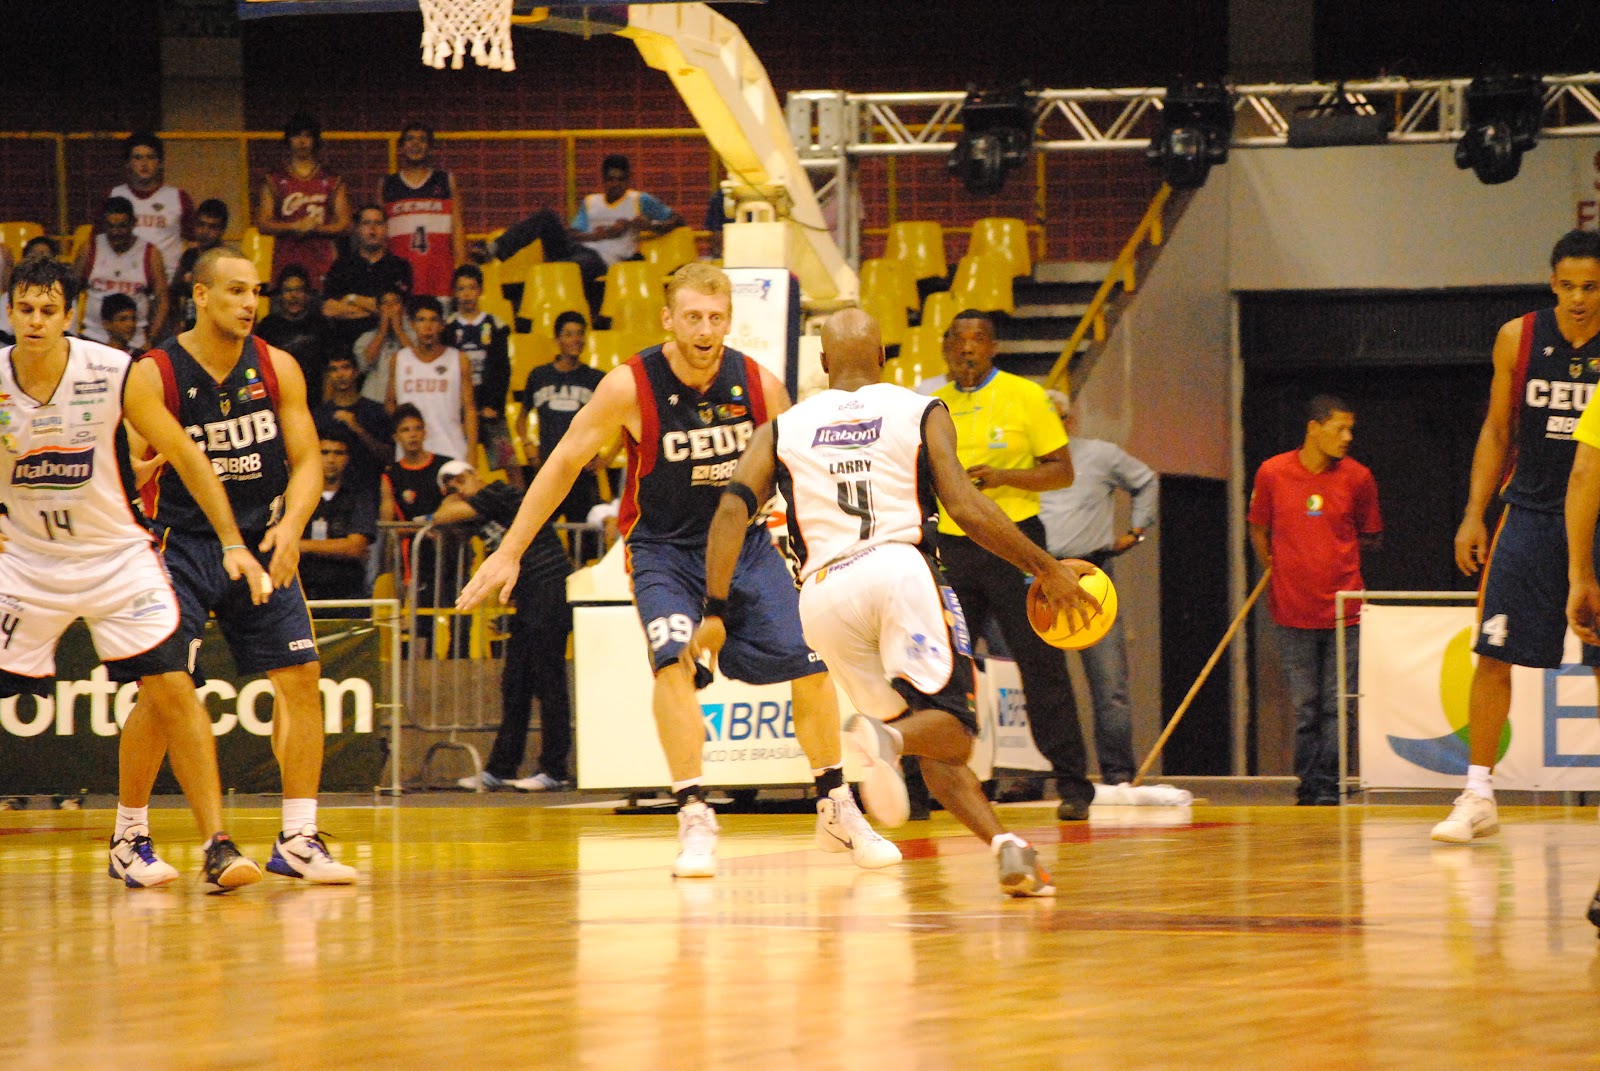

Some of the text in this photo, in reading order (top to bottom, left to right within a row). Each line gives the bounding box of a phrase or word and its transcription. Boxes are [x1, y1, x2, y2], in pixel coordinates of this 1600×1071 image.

[403, 379, 449, 394] CEUB
[229, 453, 262, 474] BRB
[829, 459, 872, 476] LARRY
[837, 480, 876, 541] 4
[40, 510, 76, 541] 14
[647, 613, 693, 651] 99
[1482, 613, 1509, 647] 4
[807, 651, 822, 663] CE
[702, 749, 727, 763] NCO
